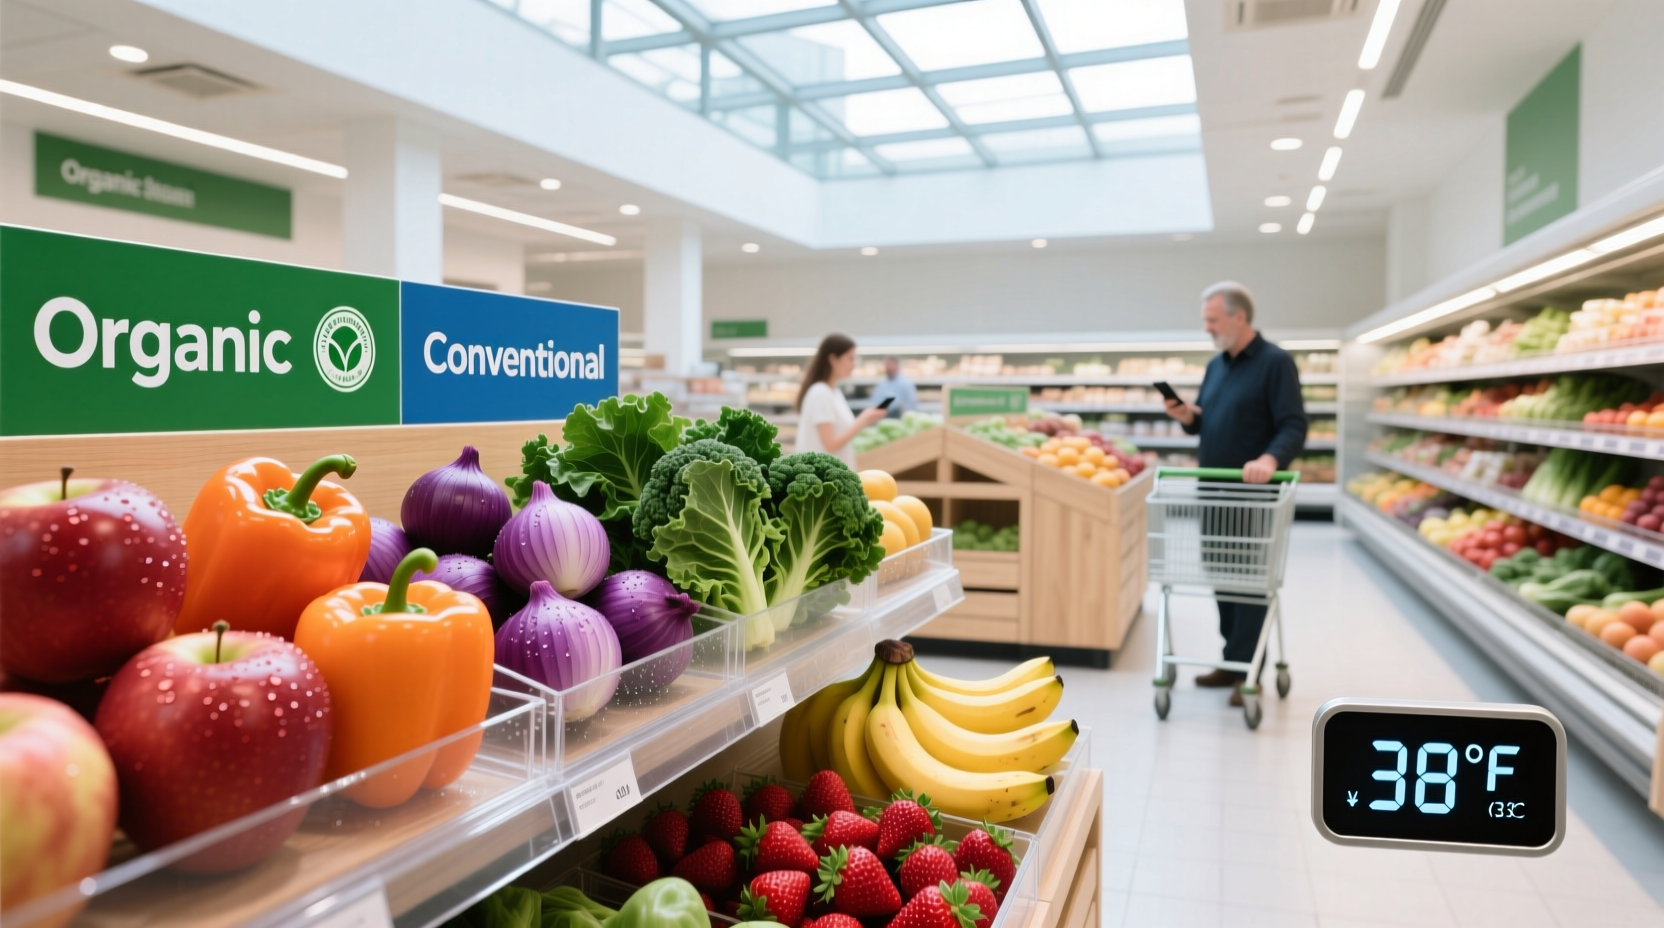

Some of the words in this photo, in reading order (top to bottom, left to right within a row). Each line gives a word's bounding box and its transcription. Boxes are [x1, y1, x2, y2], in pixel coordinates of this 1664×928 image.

[60, 158, 141, 197] Organic
[34, 297, 292, 388] Organic
[424, 332, 604, 379] Conventional
